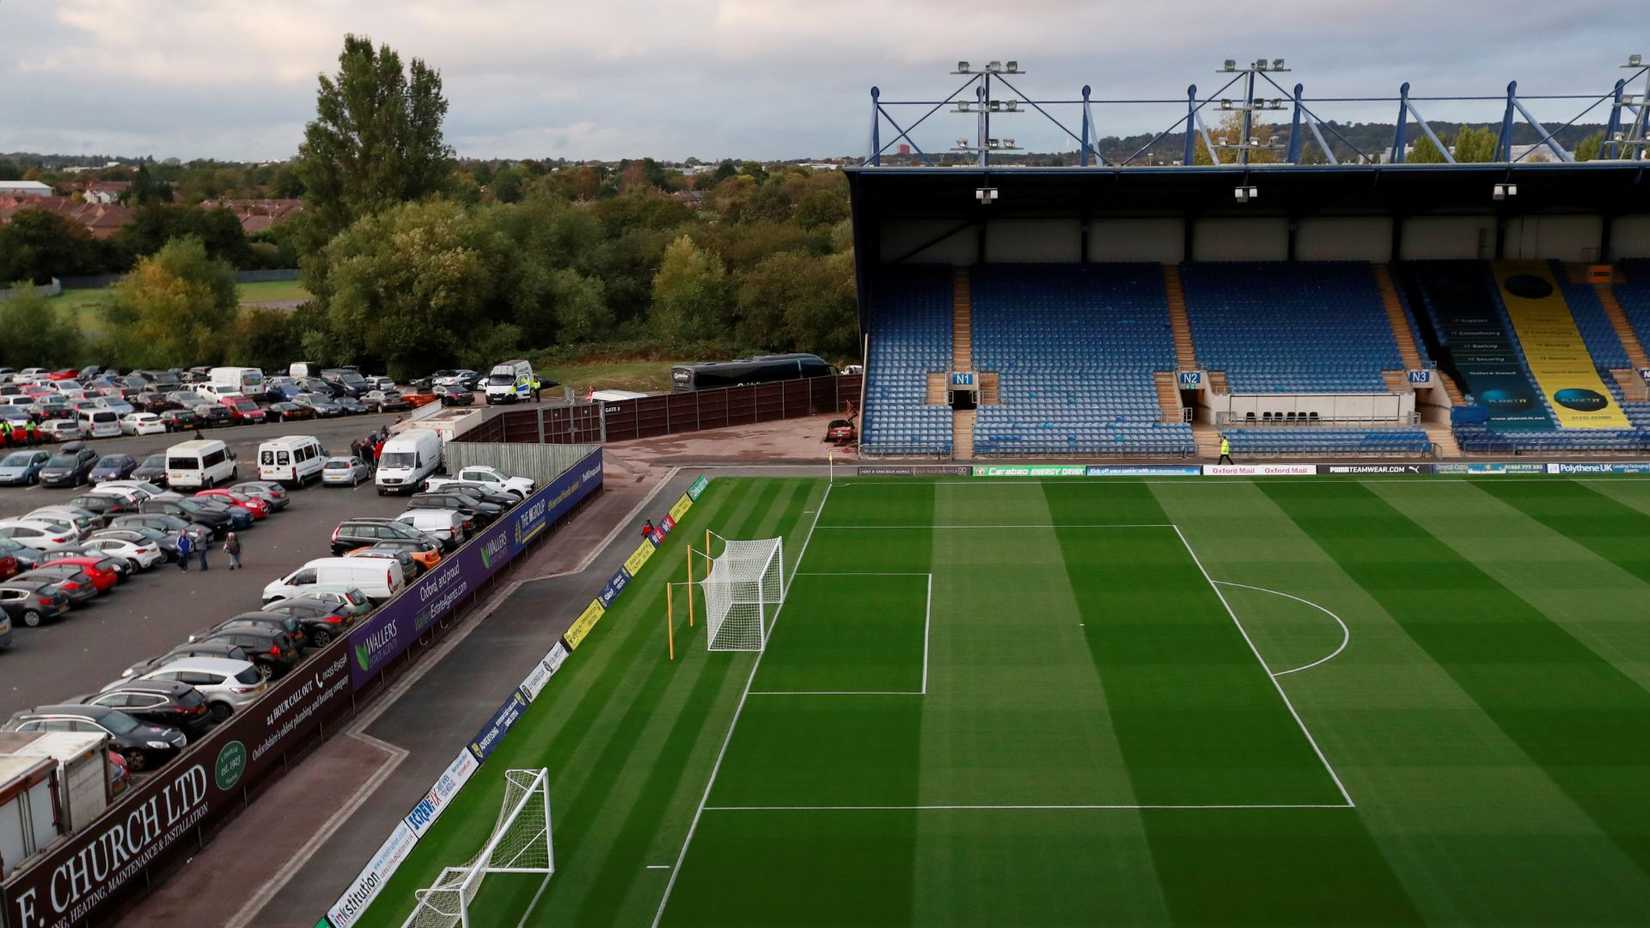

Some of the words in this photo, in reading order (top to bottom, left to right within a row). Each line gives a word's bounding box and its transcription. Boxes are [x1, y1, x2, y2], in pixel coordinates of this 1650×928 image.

[956, 374, 969, 384] N1
[1184, 373, 1197, 384] N2
[1412, 371, 1426, 382] N3
[1560, 463, 1600, 474] Polythene
[1600, 463, 1613, 472] UK
[420, 576, 438, 601] Oxford
[439, 568, 447, 588] and
[447, 559, 460, 584] proud
[366, 618, 398, 657] WALLERS
[273, 699, 290, 720] HOUR
[289, 690, 303, 707] CALL
[302, 680, 314, 697] OUT
[408, 788, 441, 830] SCREWFIX
[16, 887, 46, 928] F.
[50, 794, 162, 914] CHURCH
[162, 763, 208, 828] LTD
[70, 884, 109, 923] HEATING,
[107, 844, 160, 892] MAINTENANCE
[163, 801, 209, 847] INSTALLATION
